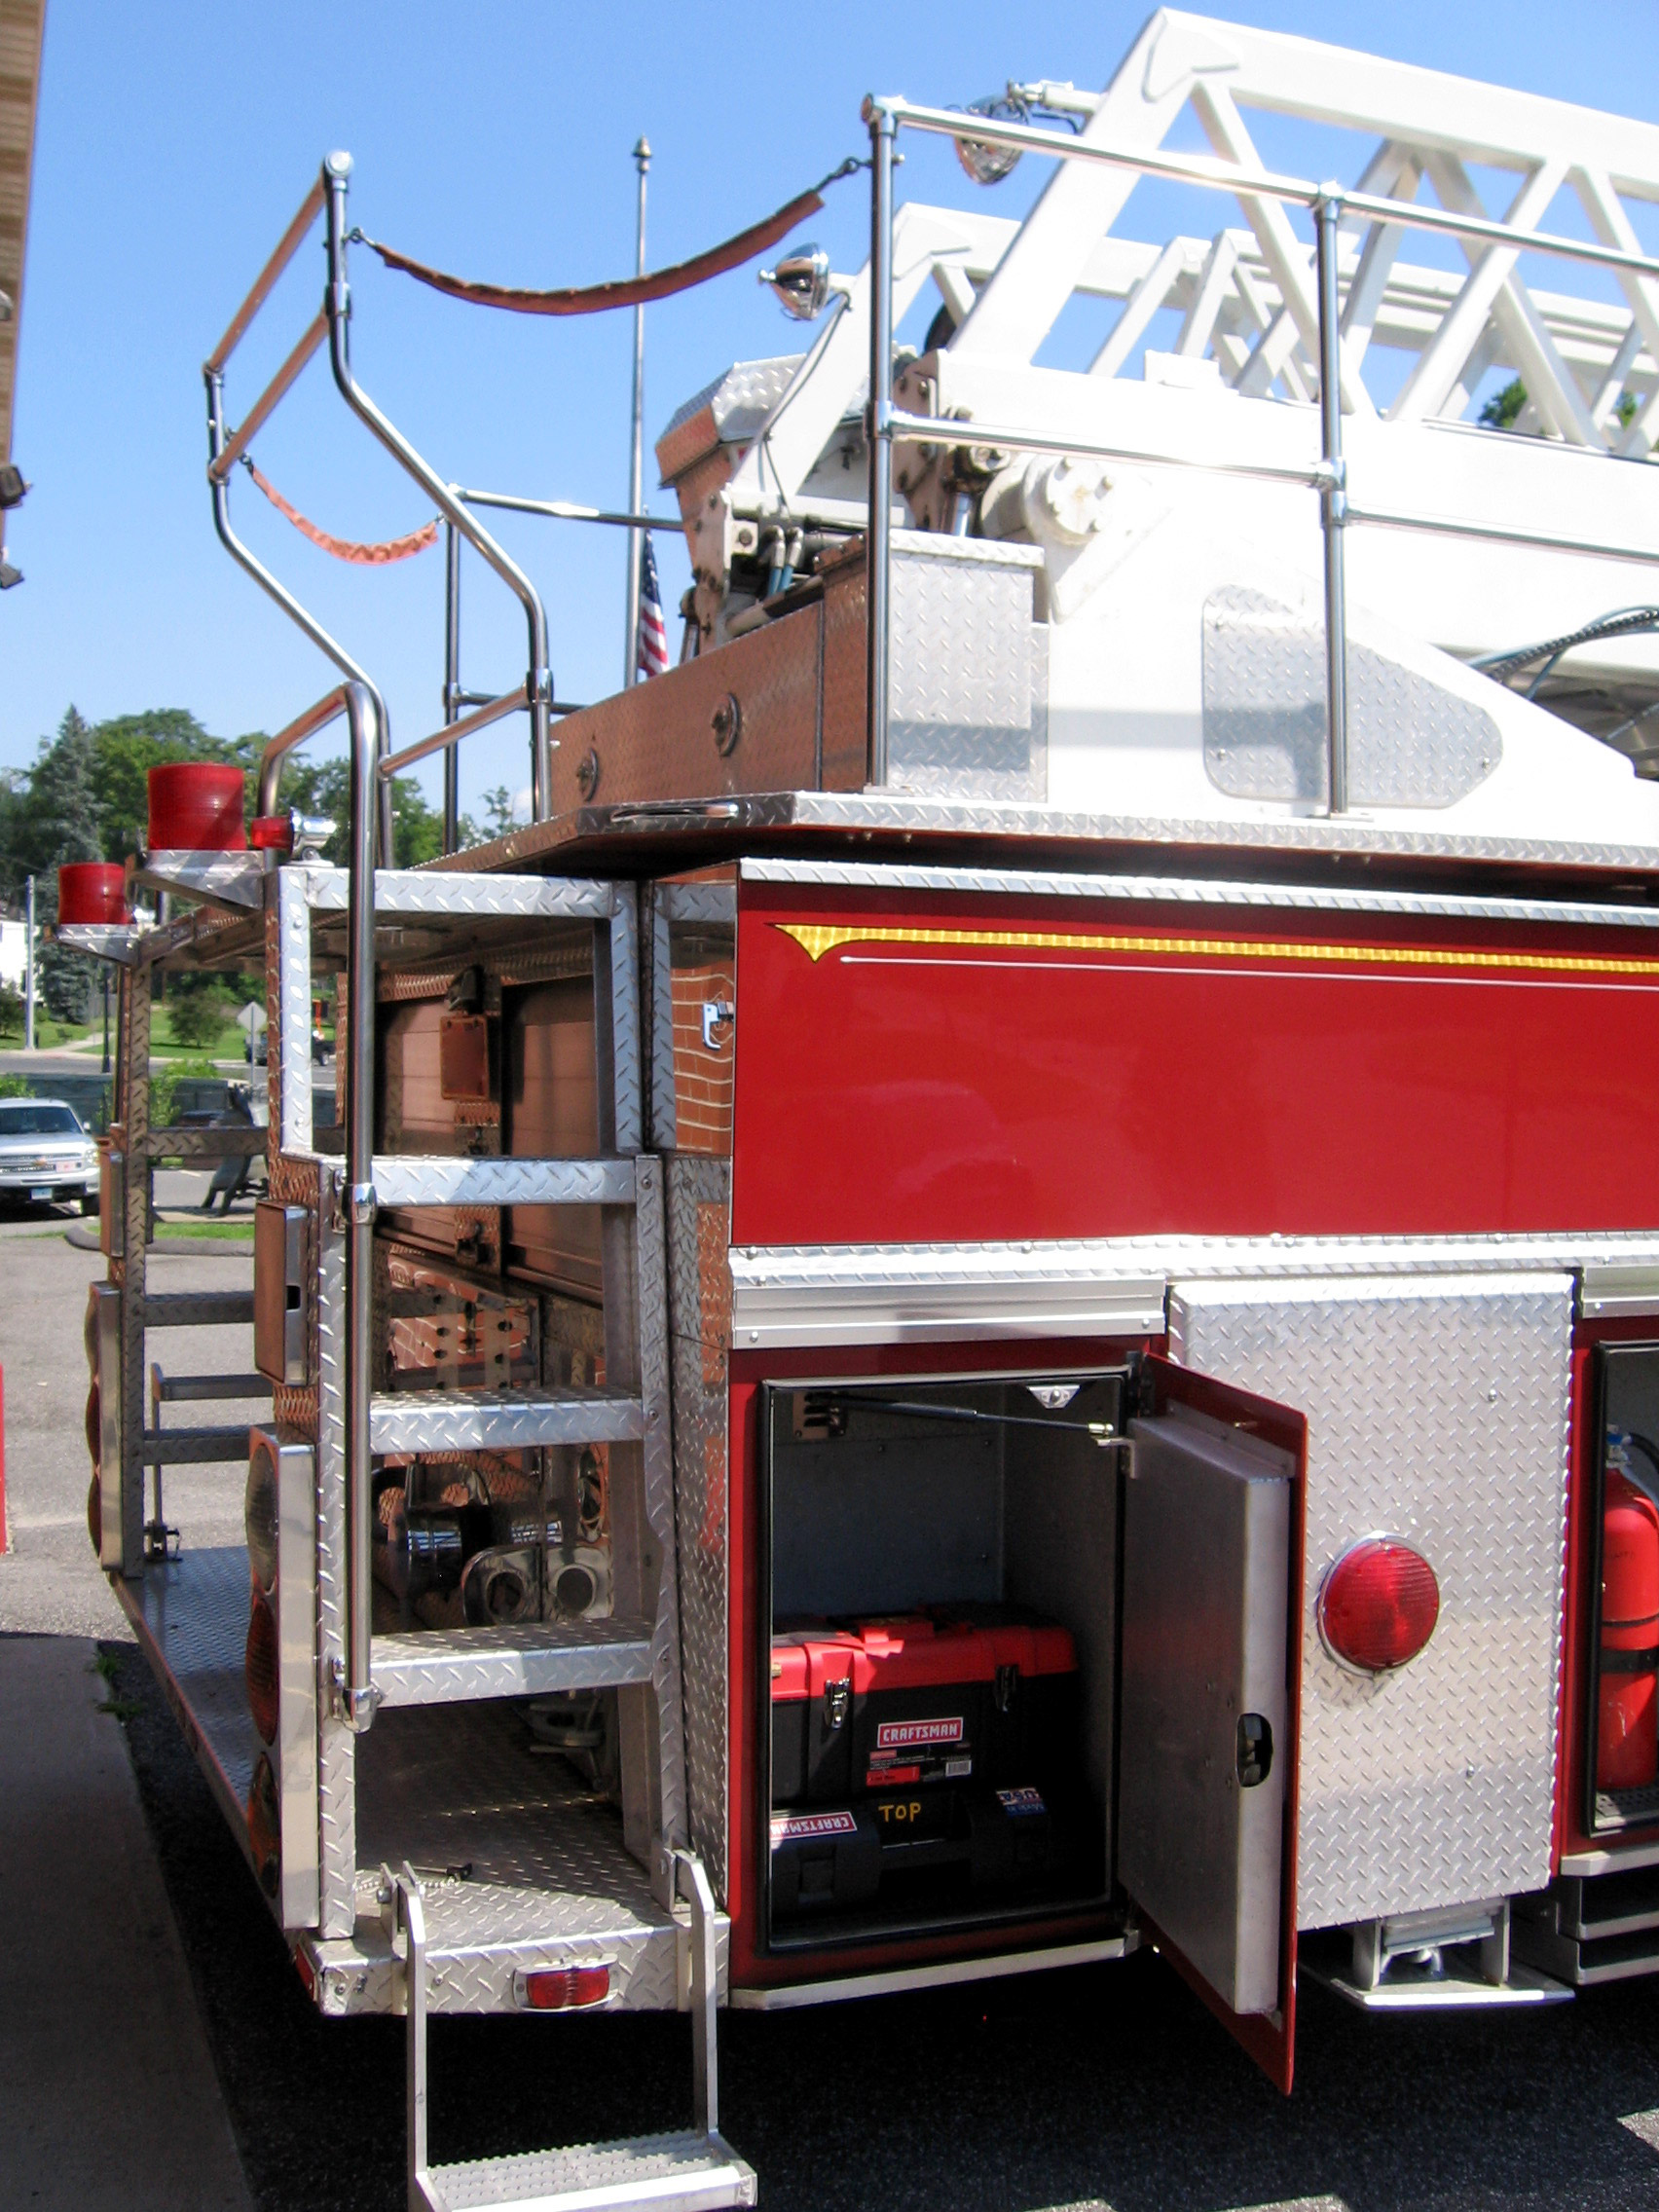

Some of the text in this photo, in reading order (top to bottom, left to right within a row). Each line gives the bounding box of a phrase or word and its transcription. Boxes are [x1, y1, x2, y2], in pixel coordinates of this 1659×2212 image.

[882, 1722, 959, 1743] CRAFTSMAN
[877, 1801, 922, 1823] TOP
[770, 1816, 850, 1835] CRAFTSMAN
